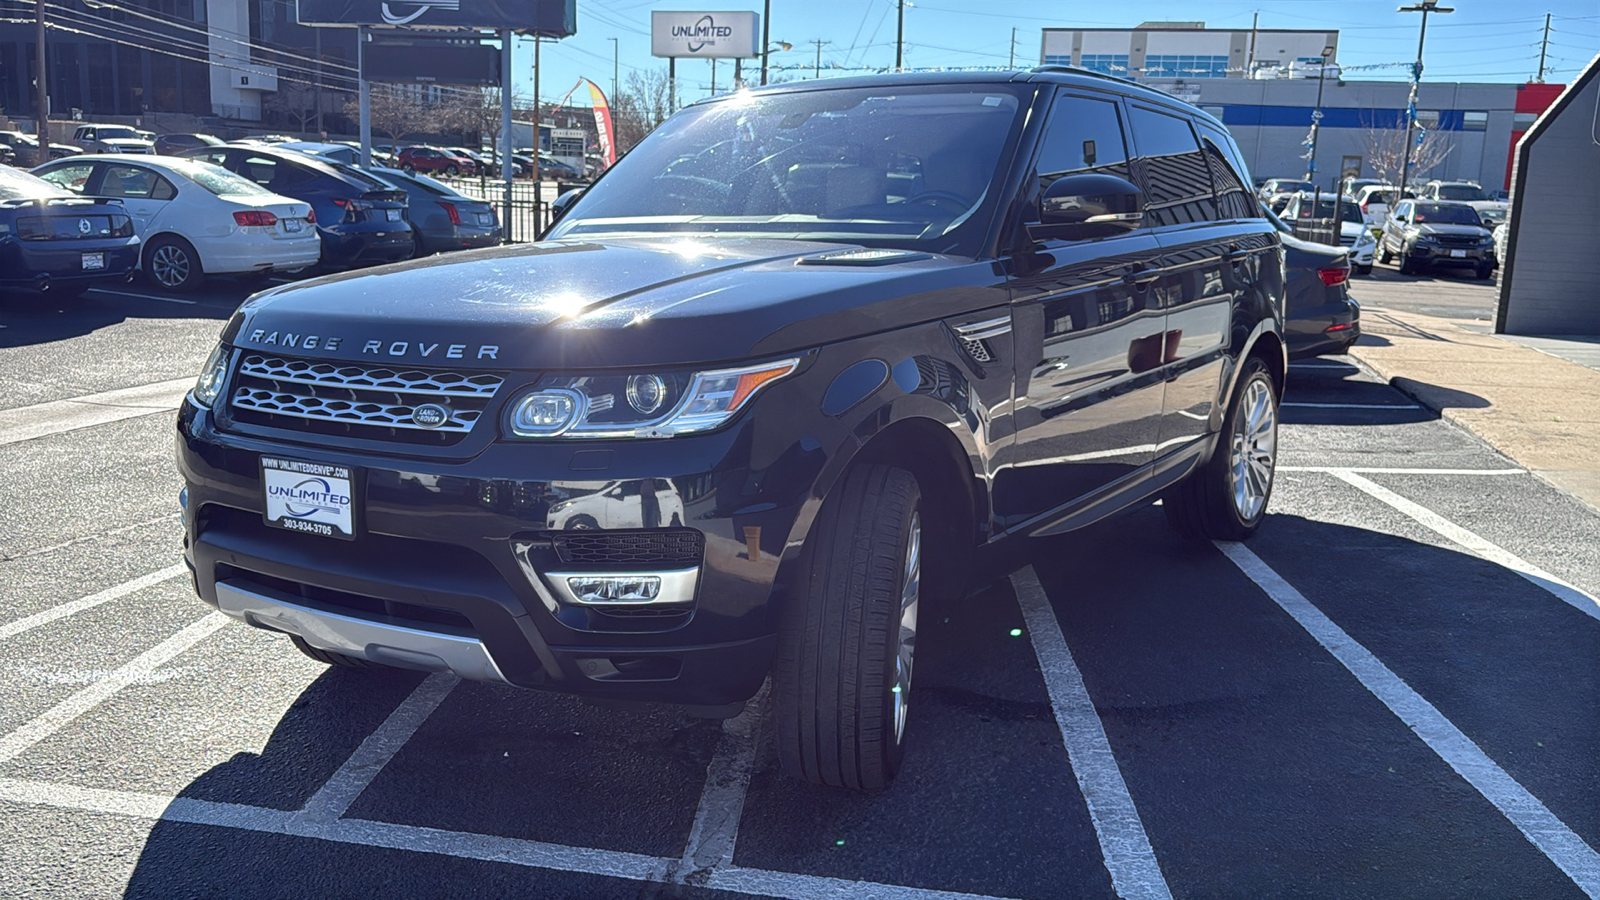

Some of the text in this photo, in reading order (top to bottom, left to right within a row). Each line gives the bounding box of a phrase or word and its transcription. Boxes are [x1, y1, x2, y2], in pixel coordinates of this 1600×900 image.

[671, 26, 732, 37] UNLIMITED
[249, 329, 499, 360] RANGE ROVER
[262, 457, 349, 479] WWWUNLIMITEDDENVE.COM
[269, 485, 350, 505] UNLIMITED
[283, 518, 332, 535] 303-934-3705
